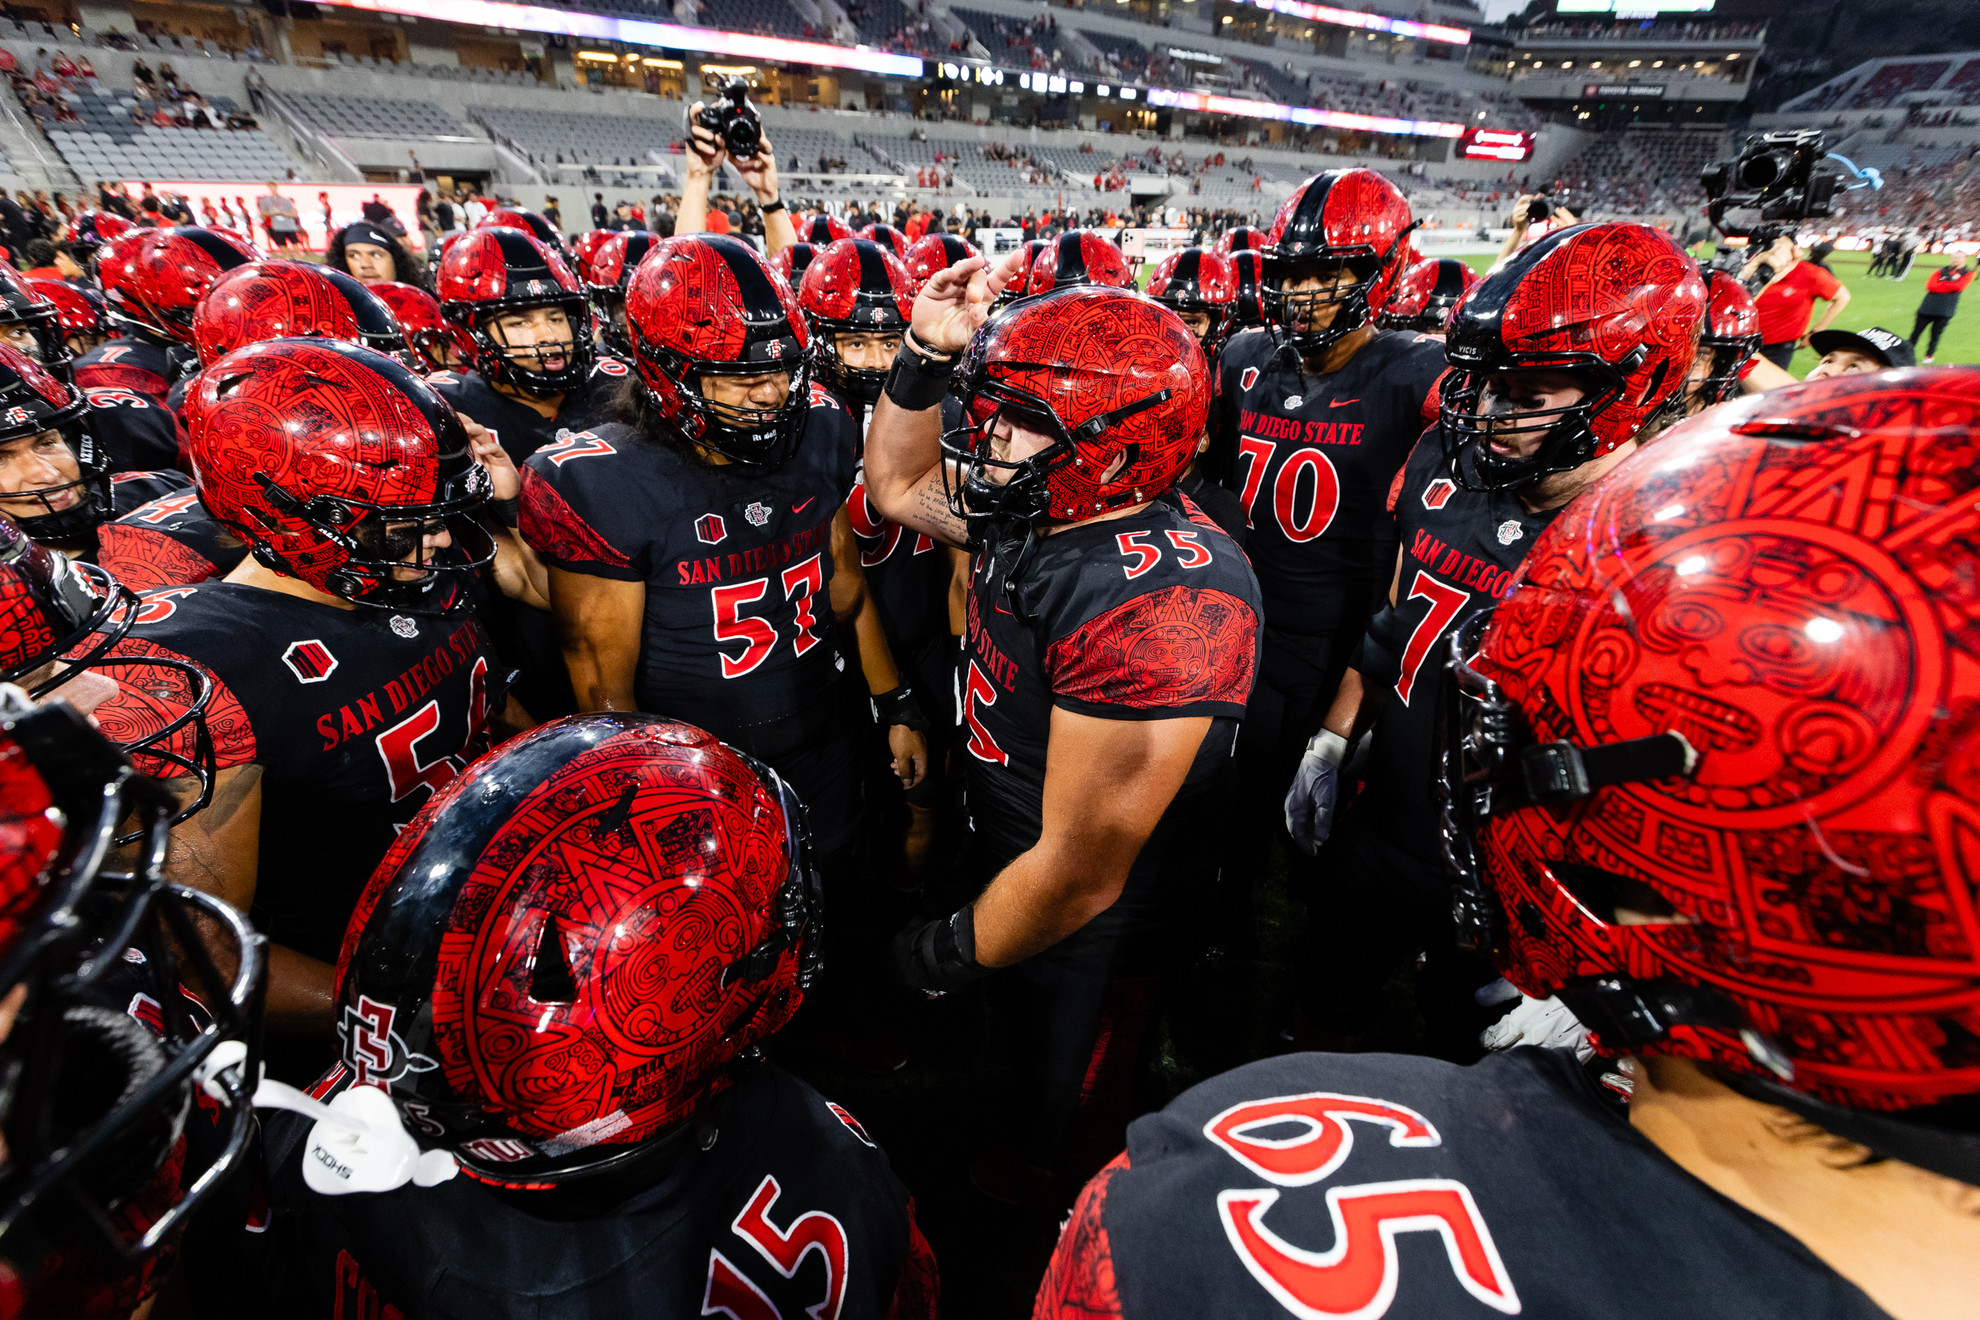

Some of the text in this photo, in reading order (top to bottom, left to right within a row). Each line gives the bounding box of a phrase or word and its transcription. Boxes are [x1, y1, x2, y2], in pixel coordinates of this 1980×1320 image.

[1458, 345, 1478, 355] VICIS
[1255, 414, 1300, 441] DIEGO
[1303, 421, 1365, 446] STATE
[1239, 435, 1340, 543] 70
[677, 556, 722, 586] SAN
[727, 539, 791, 578] DIEGO
[1115, 529, 1213, 580] 55
[1410, 528, 1514, 600] SAN DIEGO
[711, 551, 823, 680] 57
[977, 627, 1019, 694] STATE
[316, 691, 385, 752] SAN
[383, 646, 452, 716] DIEGO
[312, 1143, 354, 1180] SHOCK
[1202, 1090, 1523, 1320] 65
